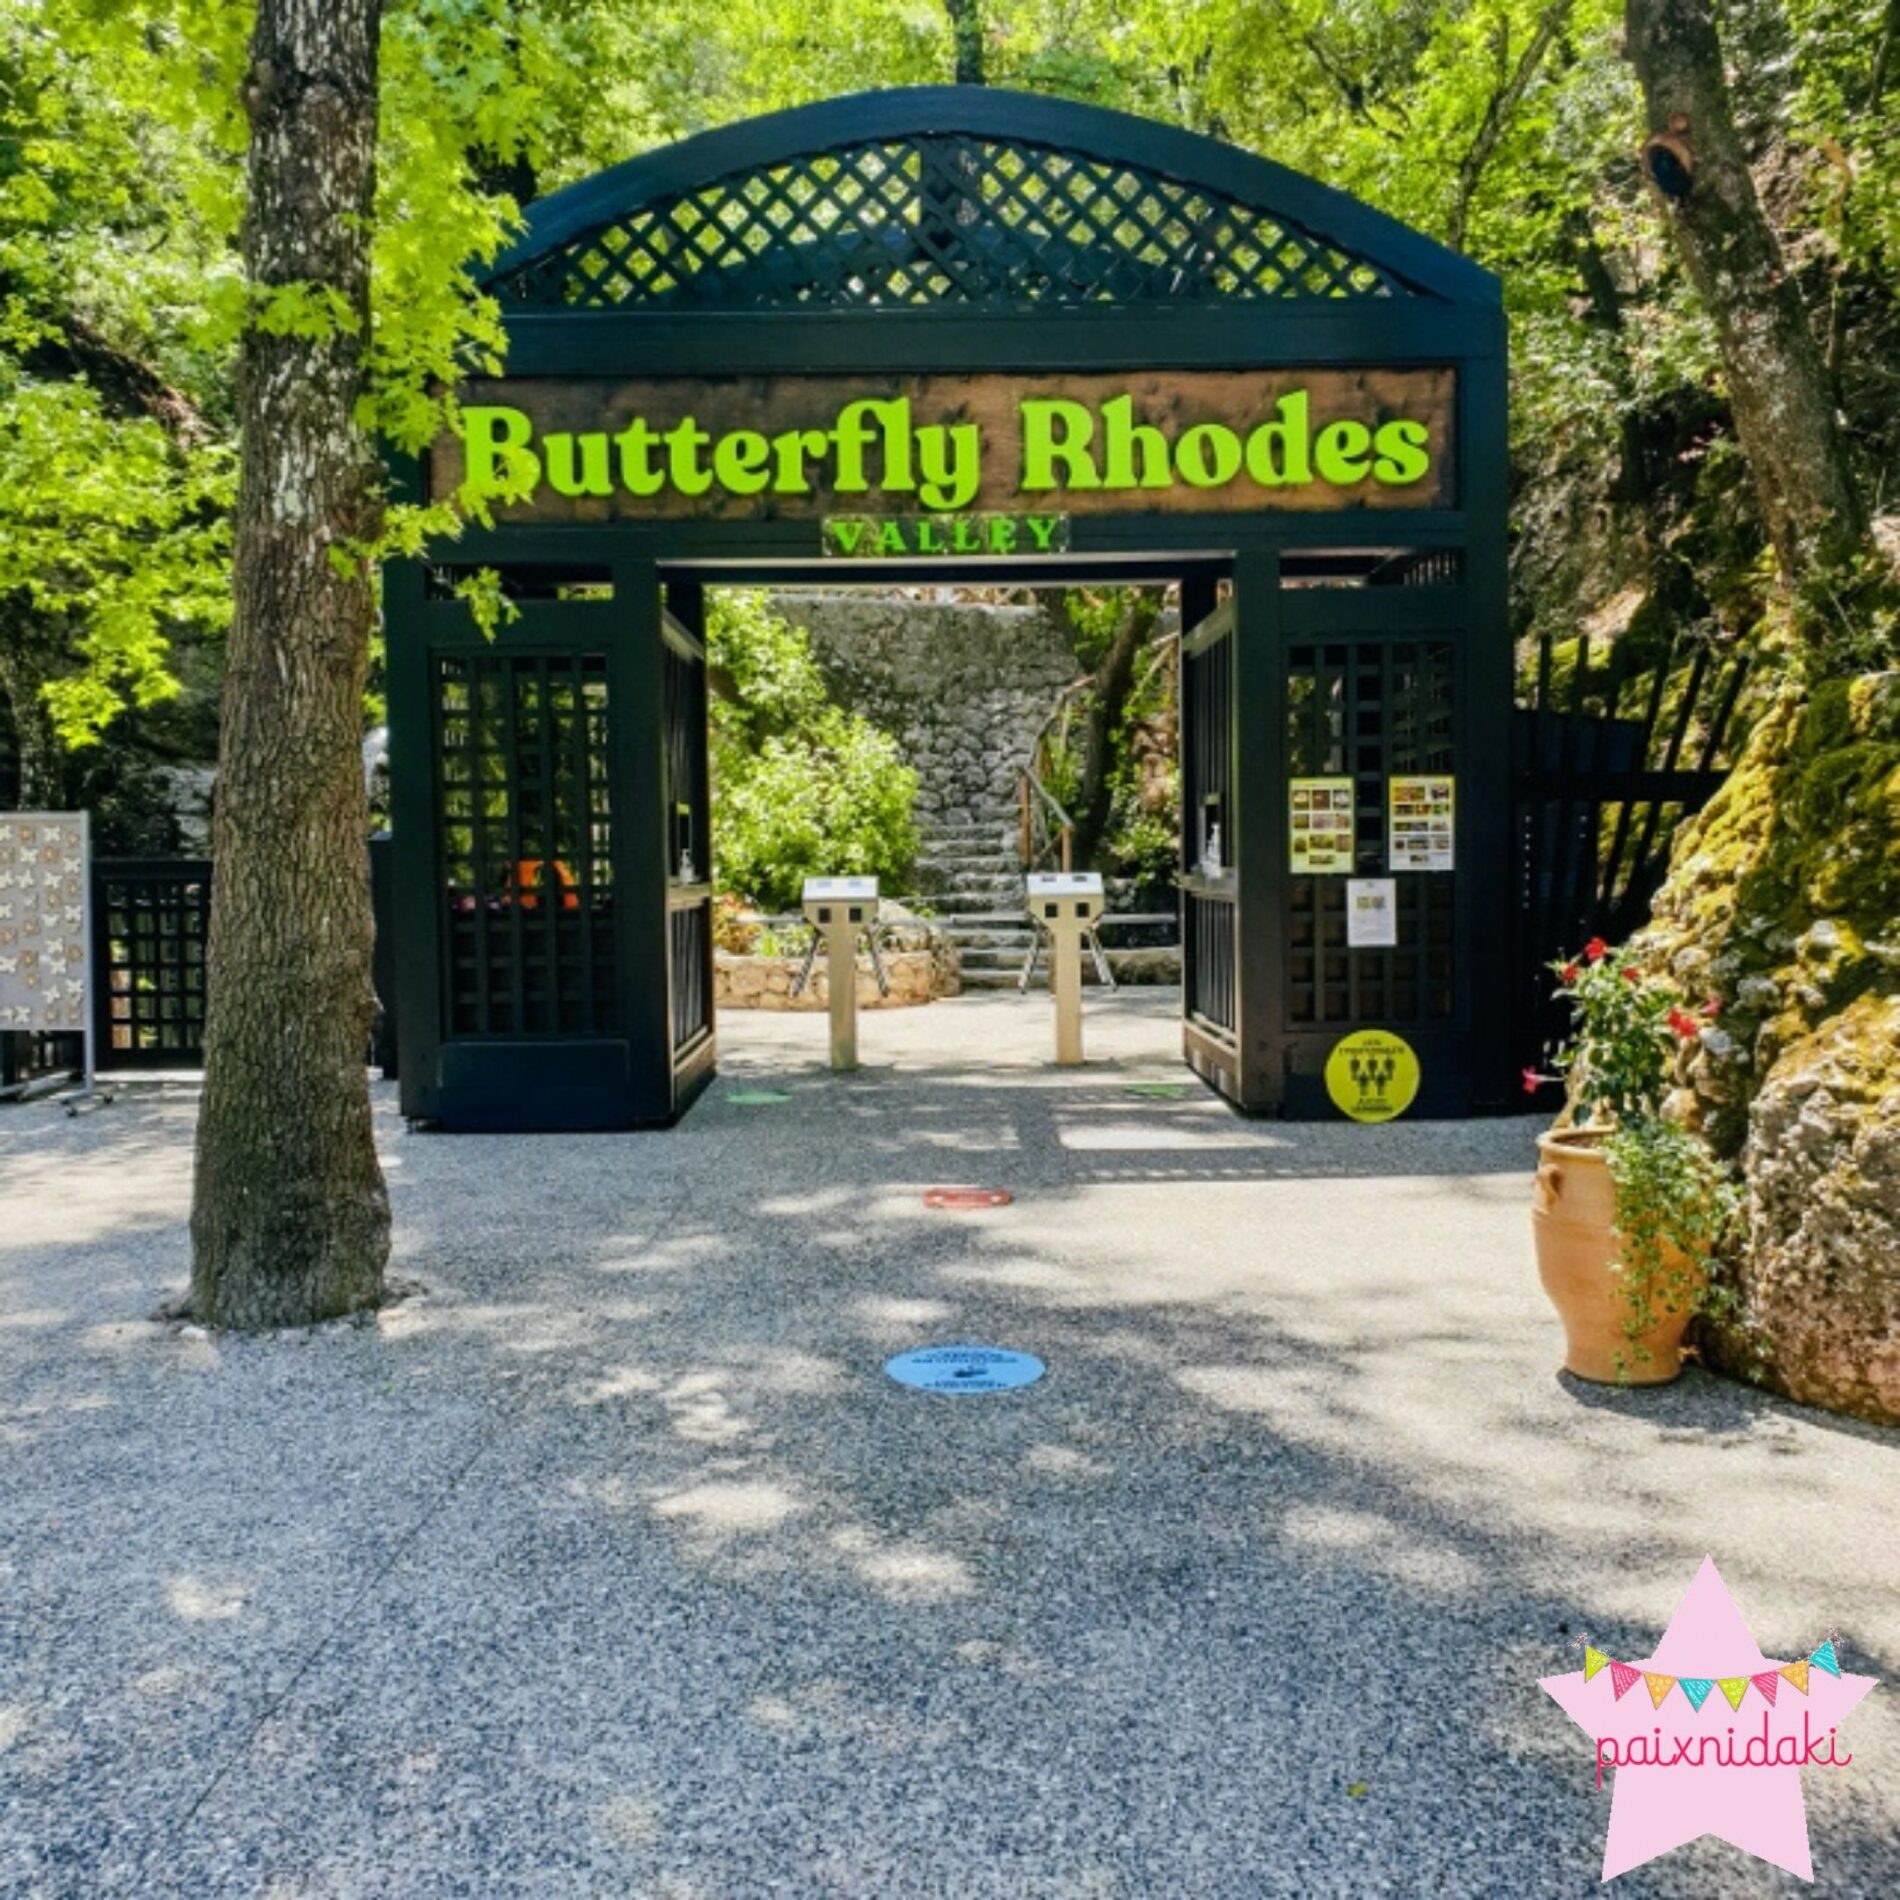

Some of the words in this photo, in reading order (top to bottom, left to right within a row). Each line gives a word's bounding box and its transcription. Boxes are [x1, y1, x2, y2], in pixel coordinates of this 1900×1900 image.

[461, 397, 981, 509] Butterfly
[1020, 390, 1430, 489] Rhodes
[831, 517, 1058, 552] VALLEY
